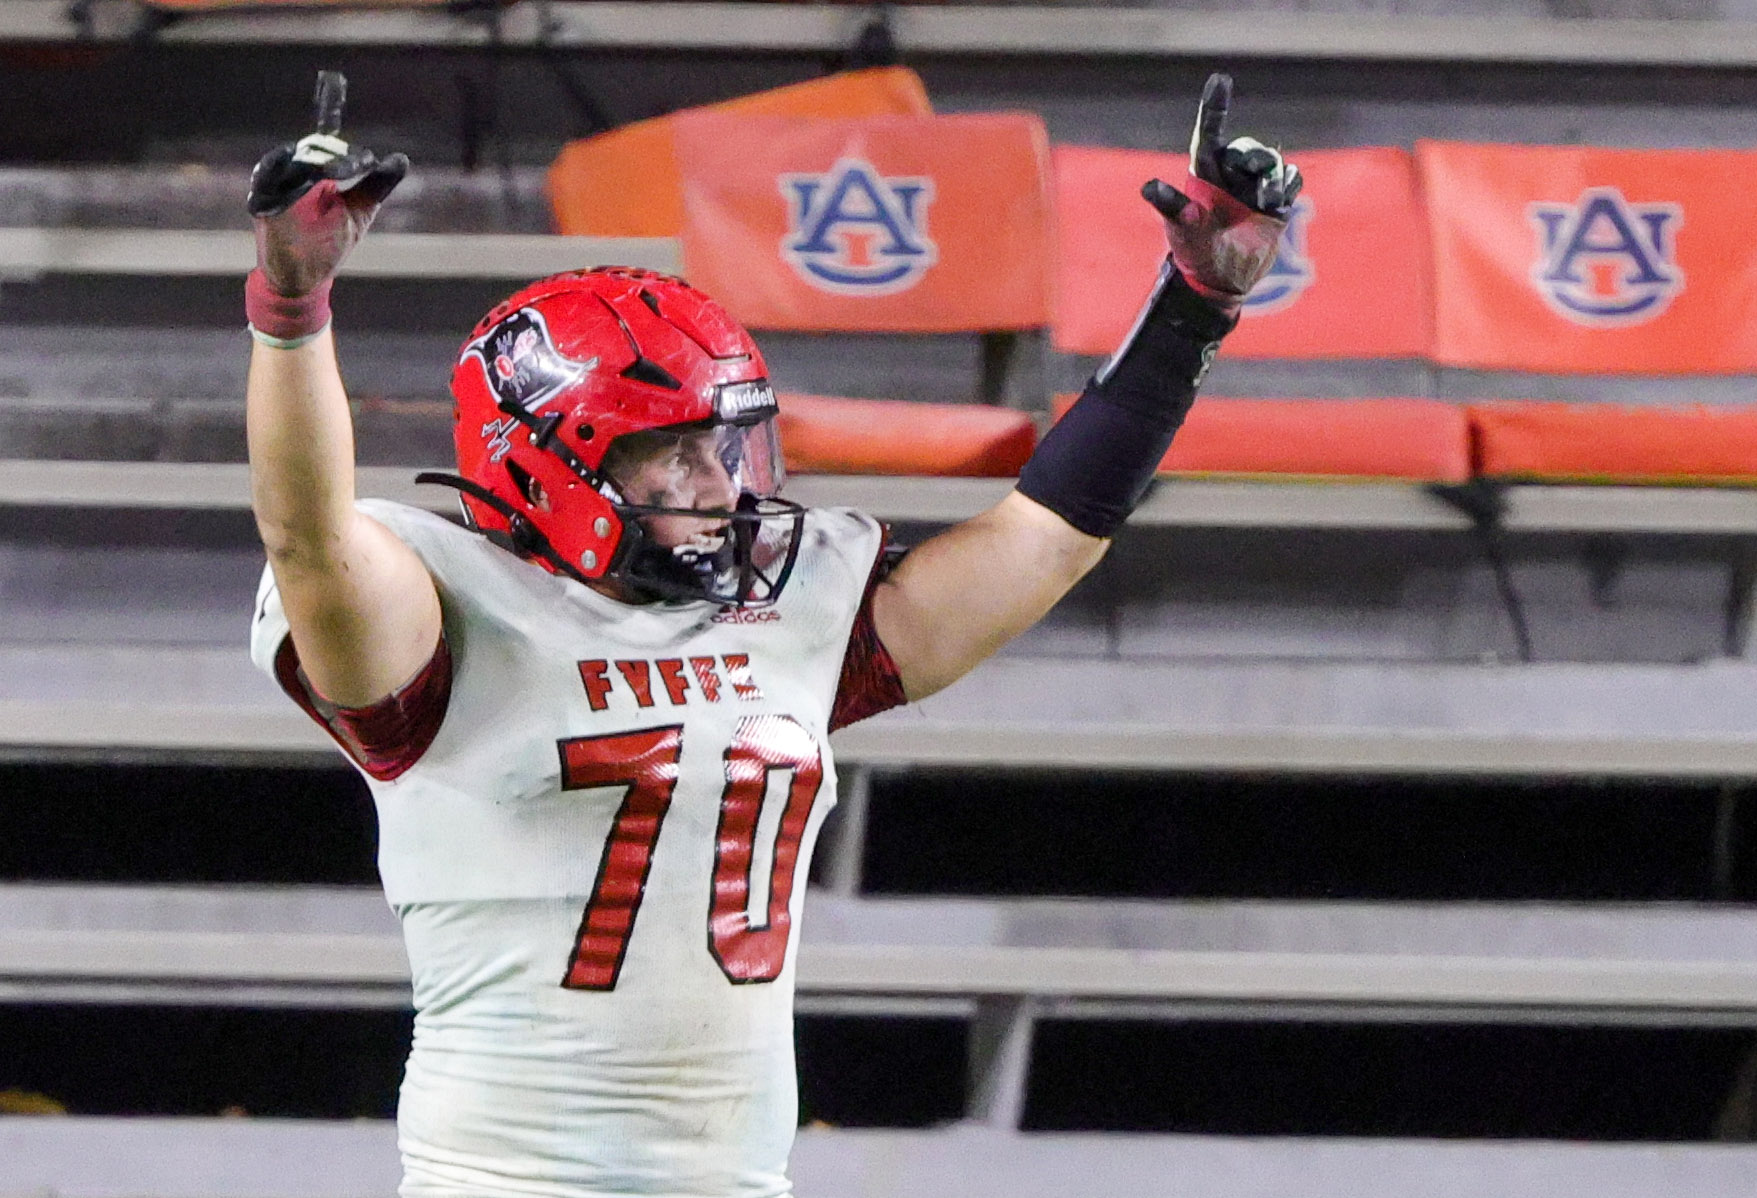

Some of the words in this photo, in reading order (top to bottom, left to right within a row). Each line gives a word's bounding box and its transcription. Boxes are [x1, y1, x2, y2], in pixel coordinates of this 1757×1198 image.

[721, 386, 776, 410] Riddell
[709, 607, 782, 625] adidas
[577, 653, 764, 710] FYFFE
[556, 714, 823, 991] 70
